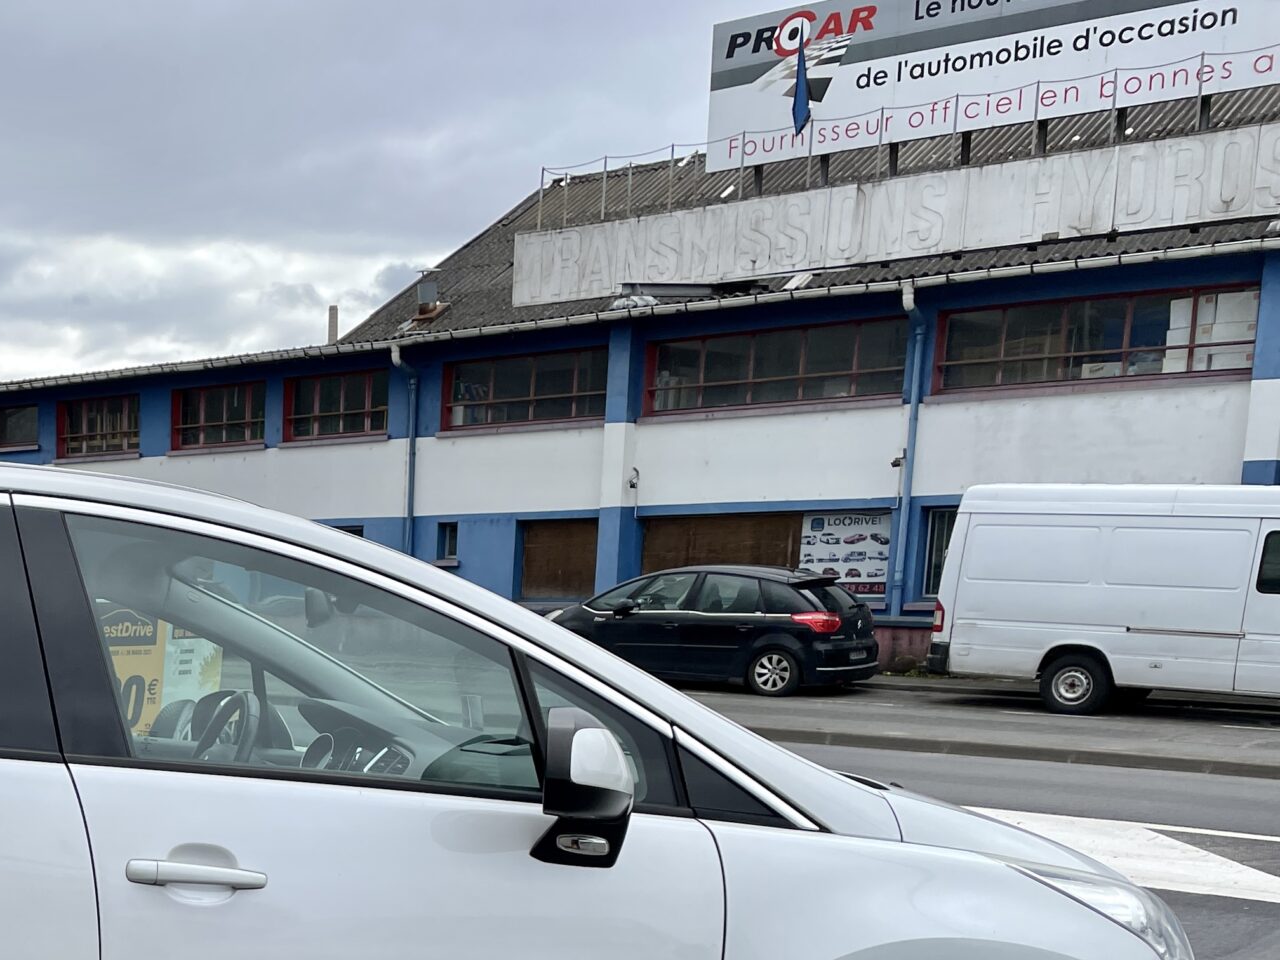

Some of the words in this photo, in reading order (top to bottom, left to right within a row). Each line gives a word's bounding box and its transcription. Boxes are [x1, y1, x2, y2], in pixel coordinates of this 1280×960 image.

[914, 0, 942, 21] Le
[856, 67, 889, 90] de
[896, 35, 1064, 83] l'automobile
[1072, 7, 1239, 52] d'occasion
[728, 113, 894, 159] Fournsseur
[908, 88, 1024, 129] offciel
[1039, 85, 1080, 108] en
[1099, 60, 1234, 99] bonnes
[103, 621, 154, 638] estDrive
